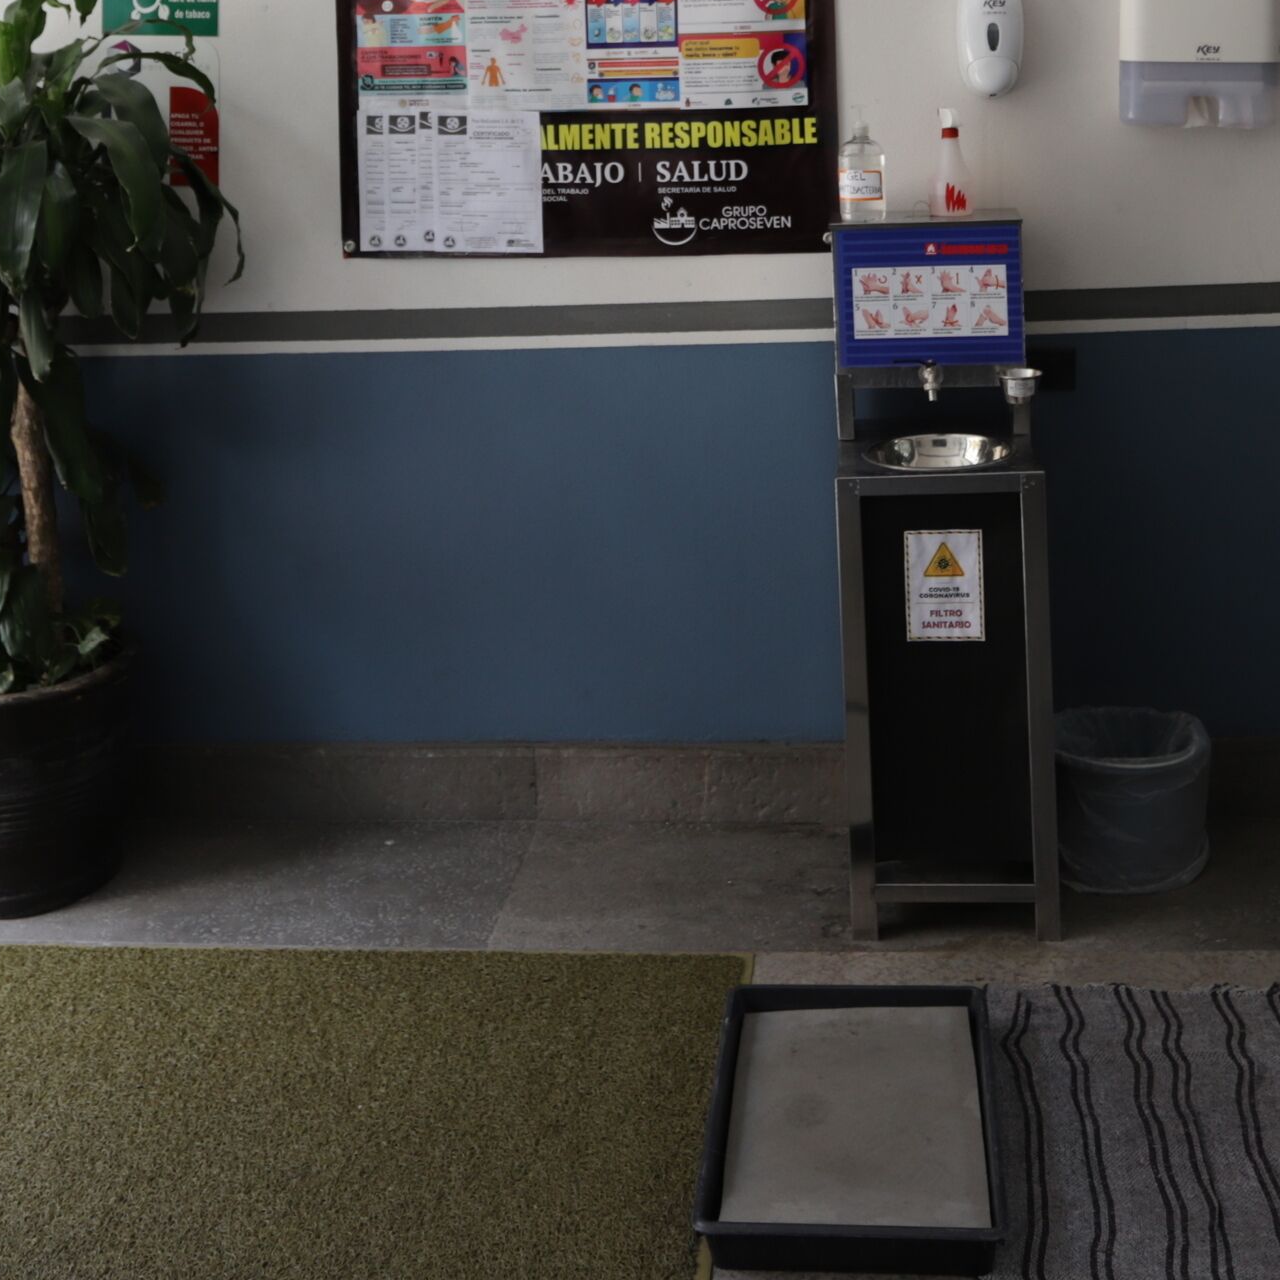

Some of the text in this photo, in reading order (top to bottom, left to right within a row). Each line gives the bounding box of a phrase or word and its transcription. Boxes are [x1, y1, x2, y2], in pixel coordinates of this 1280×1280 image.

[175, 9, 211, 19] de tabaco
[644, 117, 818, 149] RESPONSABLE
[655, 160, 749, 183] SALUD
[847, 170, 866, 181] GEL
[557, 187, 589, 195] TRABAJO
[658, 186, 700, 194] SECRETARÍA
[713, 185, 737, 193] SALUD
[721, 205, 767, 217] GRUPO
[698, 216, 792, 230] CAPROSEVEN
[930, 609, 963, 618] FILTRO
[921, 621, 971, 629] SANITARIO
